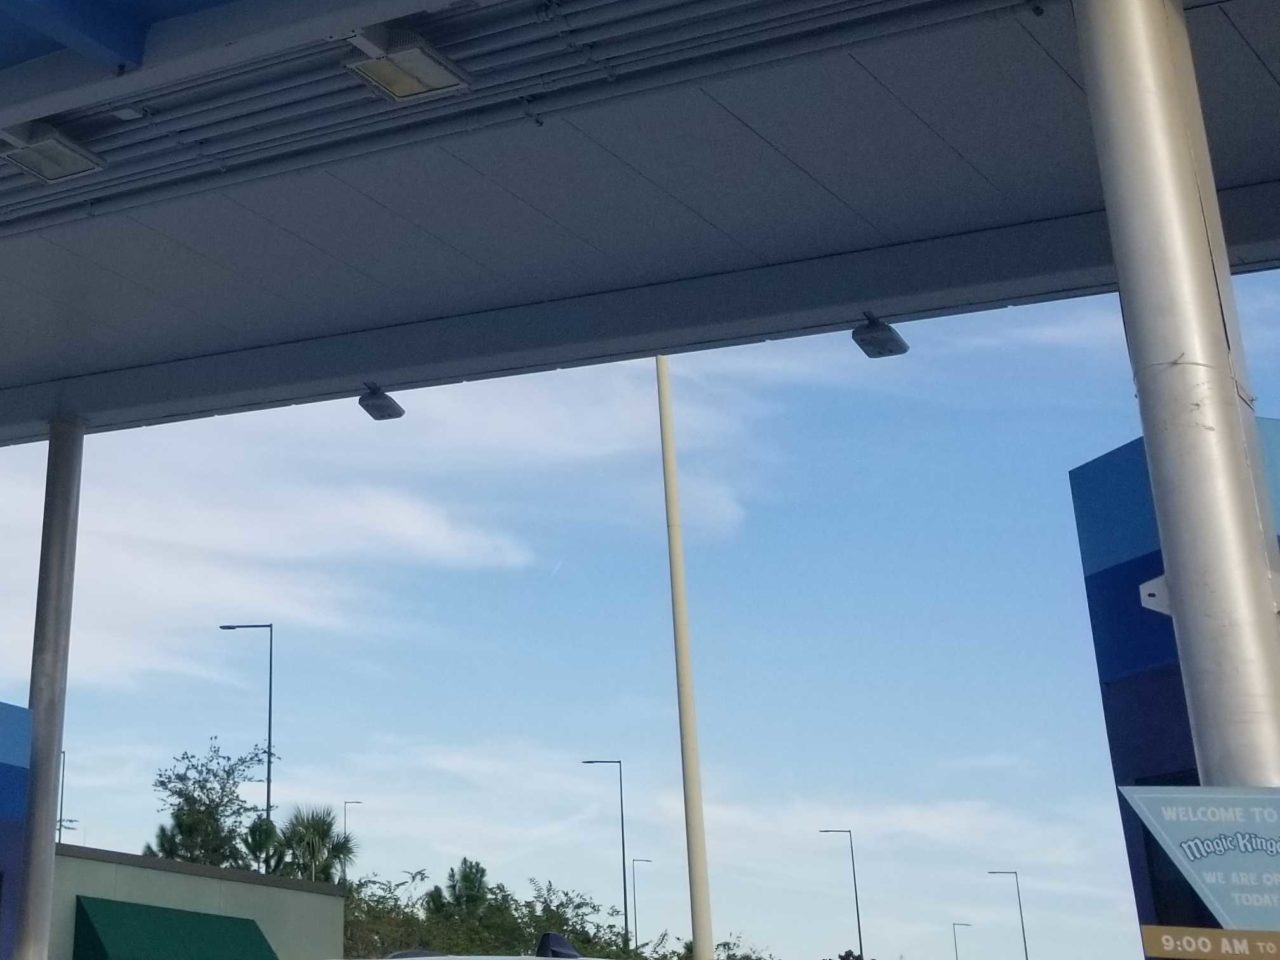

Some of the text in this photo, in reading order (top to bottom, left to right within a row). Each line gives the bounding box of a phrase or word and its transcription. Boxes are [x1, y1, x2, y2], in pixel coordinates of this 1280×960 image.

[1161, 806, 1278, 823] WELCOME TO
[1181, 833, 1234, 862] Magic
[1202, 871, 1226, 885] WE
[1231, 871, 1259, 886] ARE
[1231, 892, 1280, 907] TODAY
[1160, 934, 1277, 955] 9:00 AM TO
